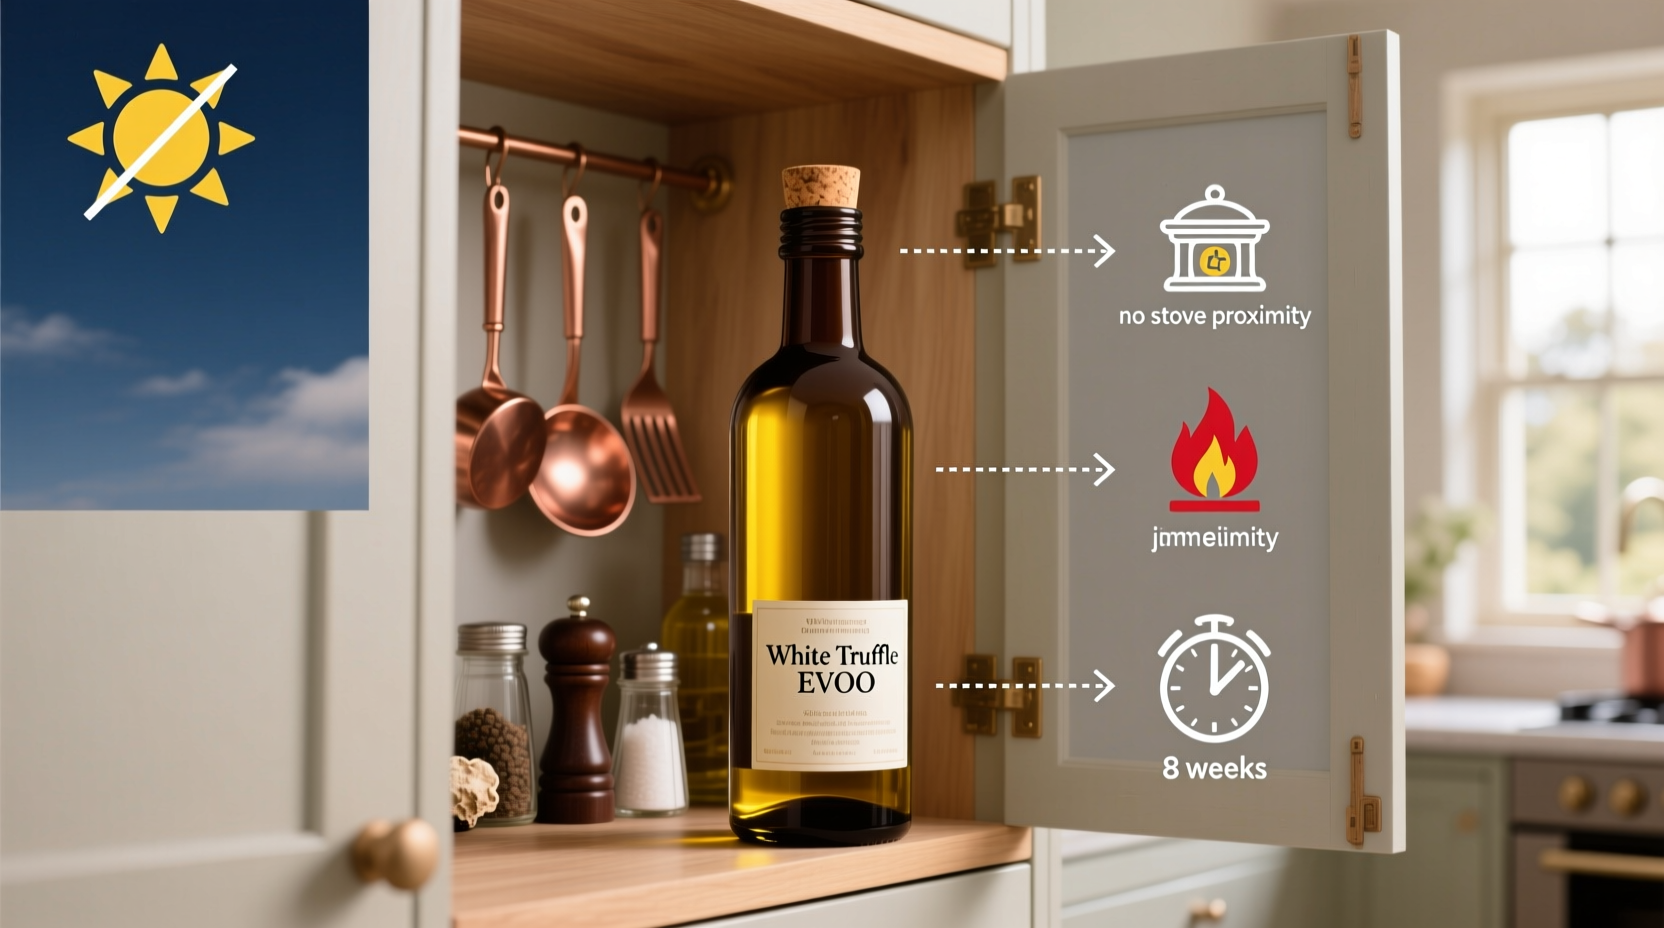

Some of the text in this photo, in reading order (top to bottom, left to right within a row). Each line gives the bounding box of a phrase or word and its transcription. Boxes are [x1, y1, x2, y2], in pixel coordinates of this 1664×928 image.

[765, 643, 899, 666] White Truffle
[797, 670, 876, 694] EVOO
